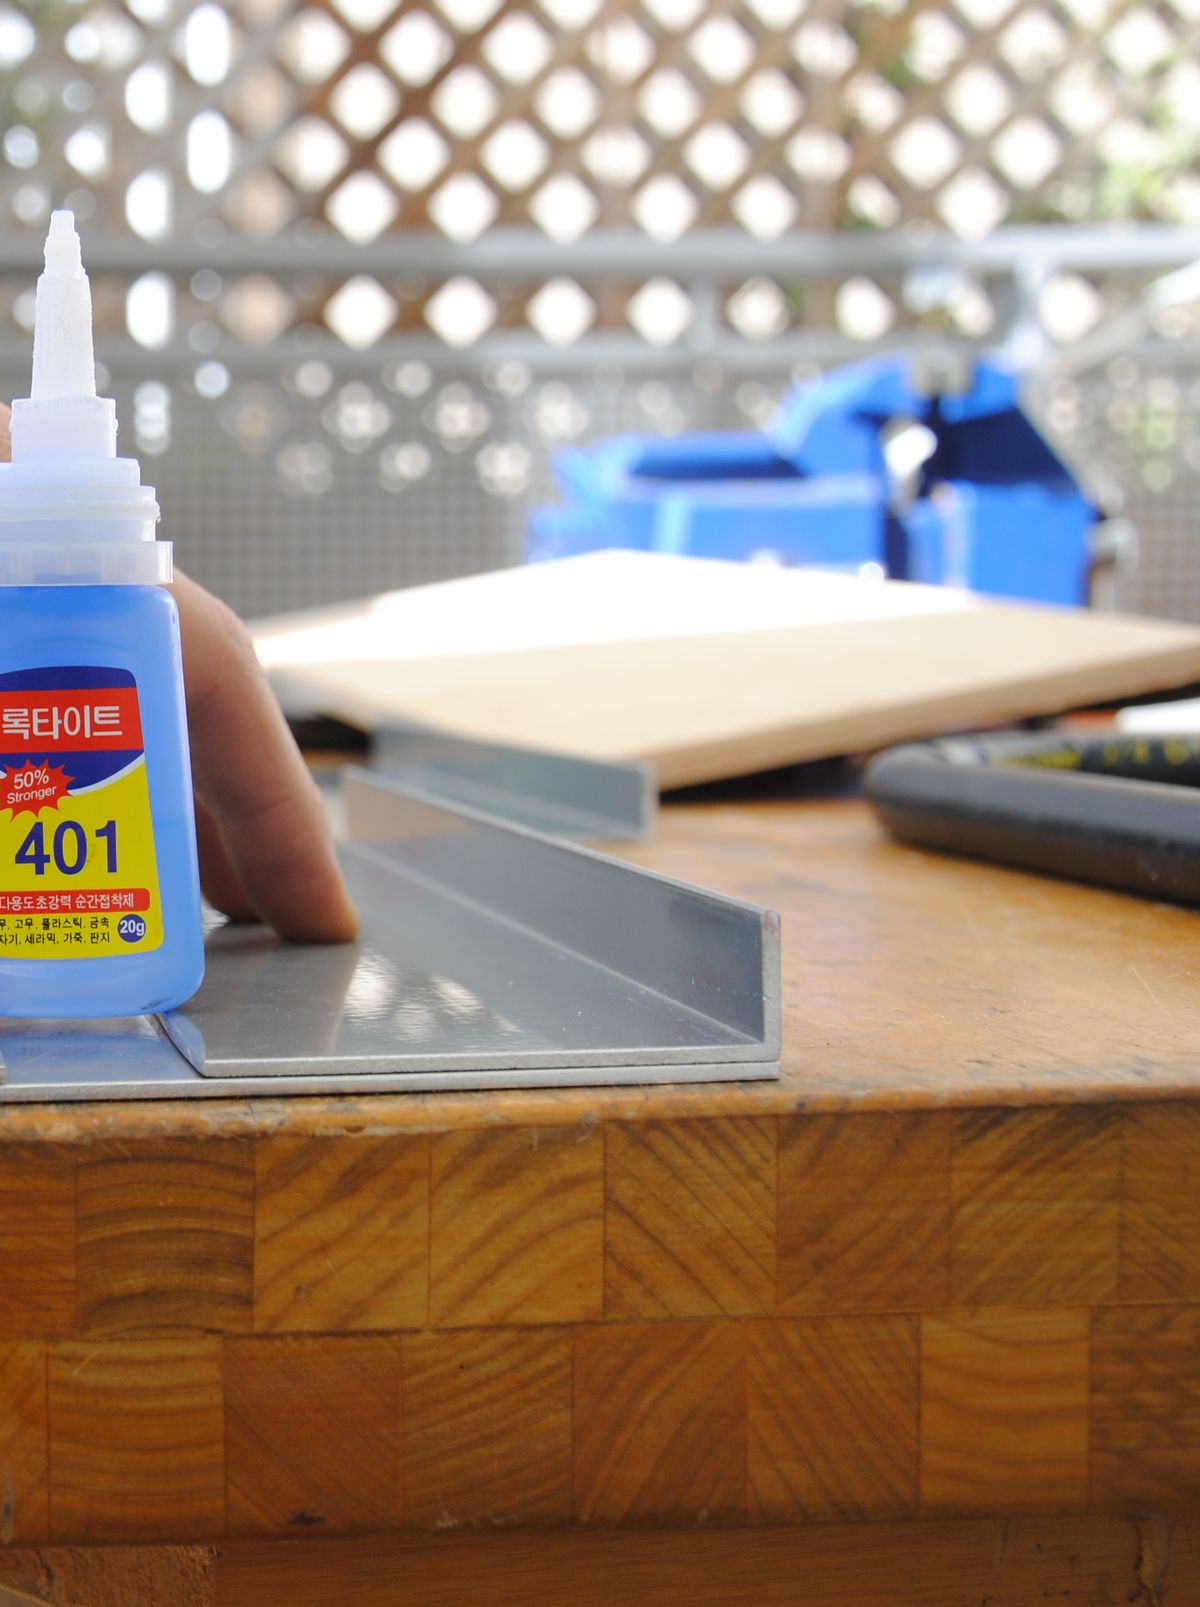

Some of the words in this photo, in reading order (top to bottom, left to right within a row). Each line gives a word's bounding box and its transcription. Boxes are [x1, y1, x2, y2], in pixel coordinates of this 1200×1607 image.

[2, 705, 123, 740] 록타이트
[13, 768, 50, 790] 50%
[7, 786, 57, 804] Stronger
[15, 820, 117, 875] 401
[75, 893, 134, 909] 순간접착제
[90, 916, 109, 929] 금속
[120, 920, 145, 936] 20g
